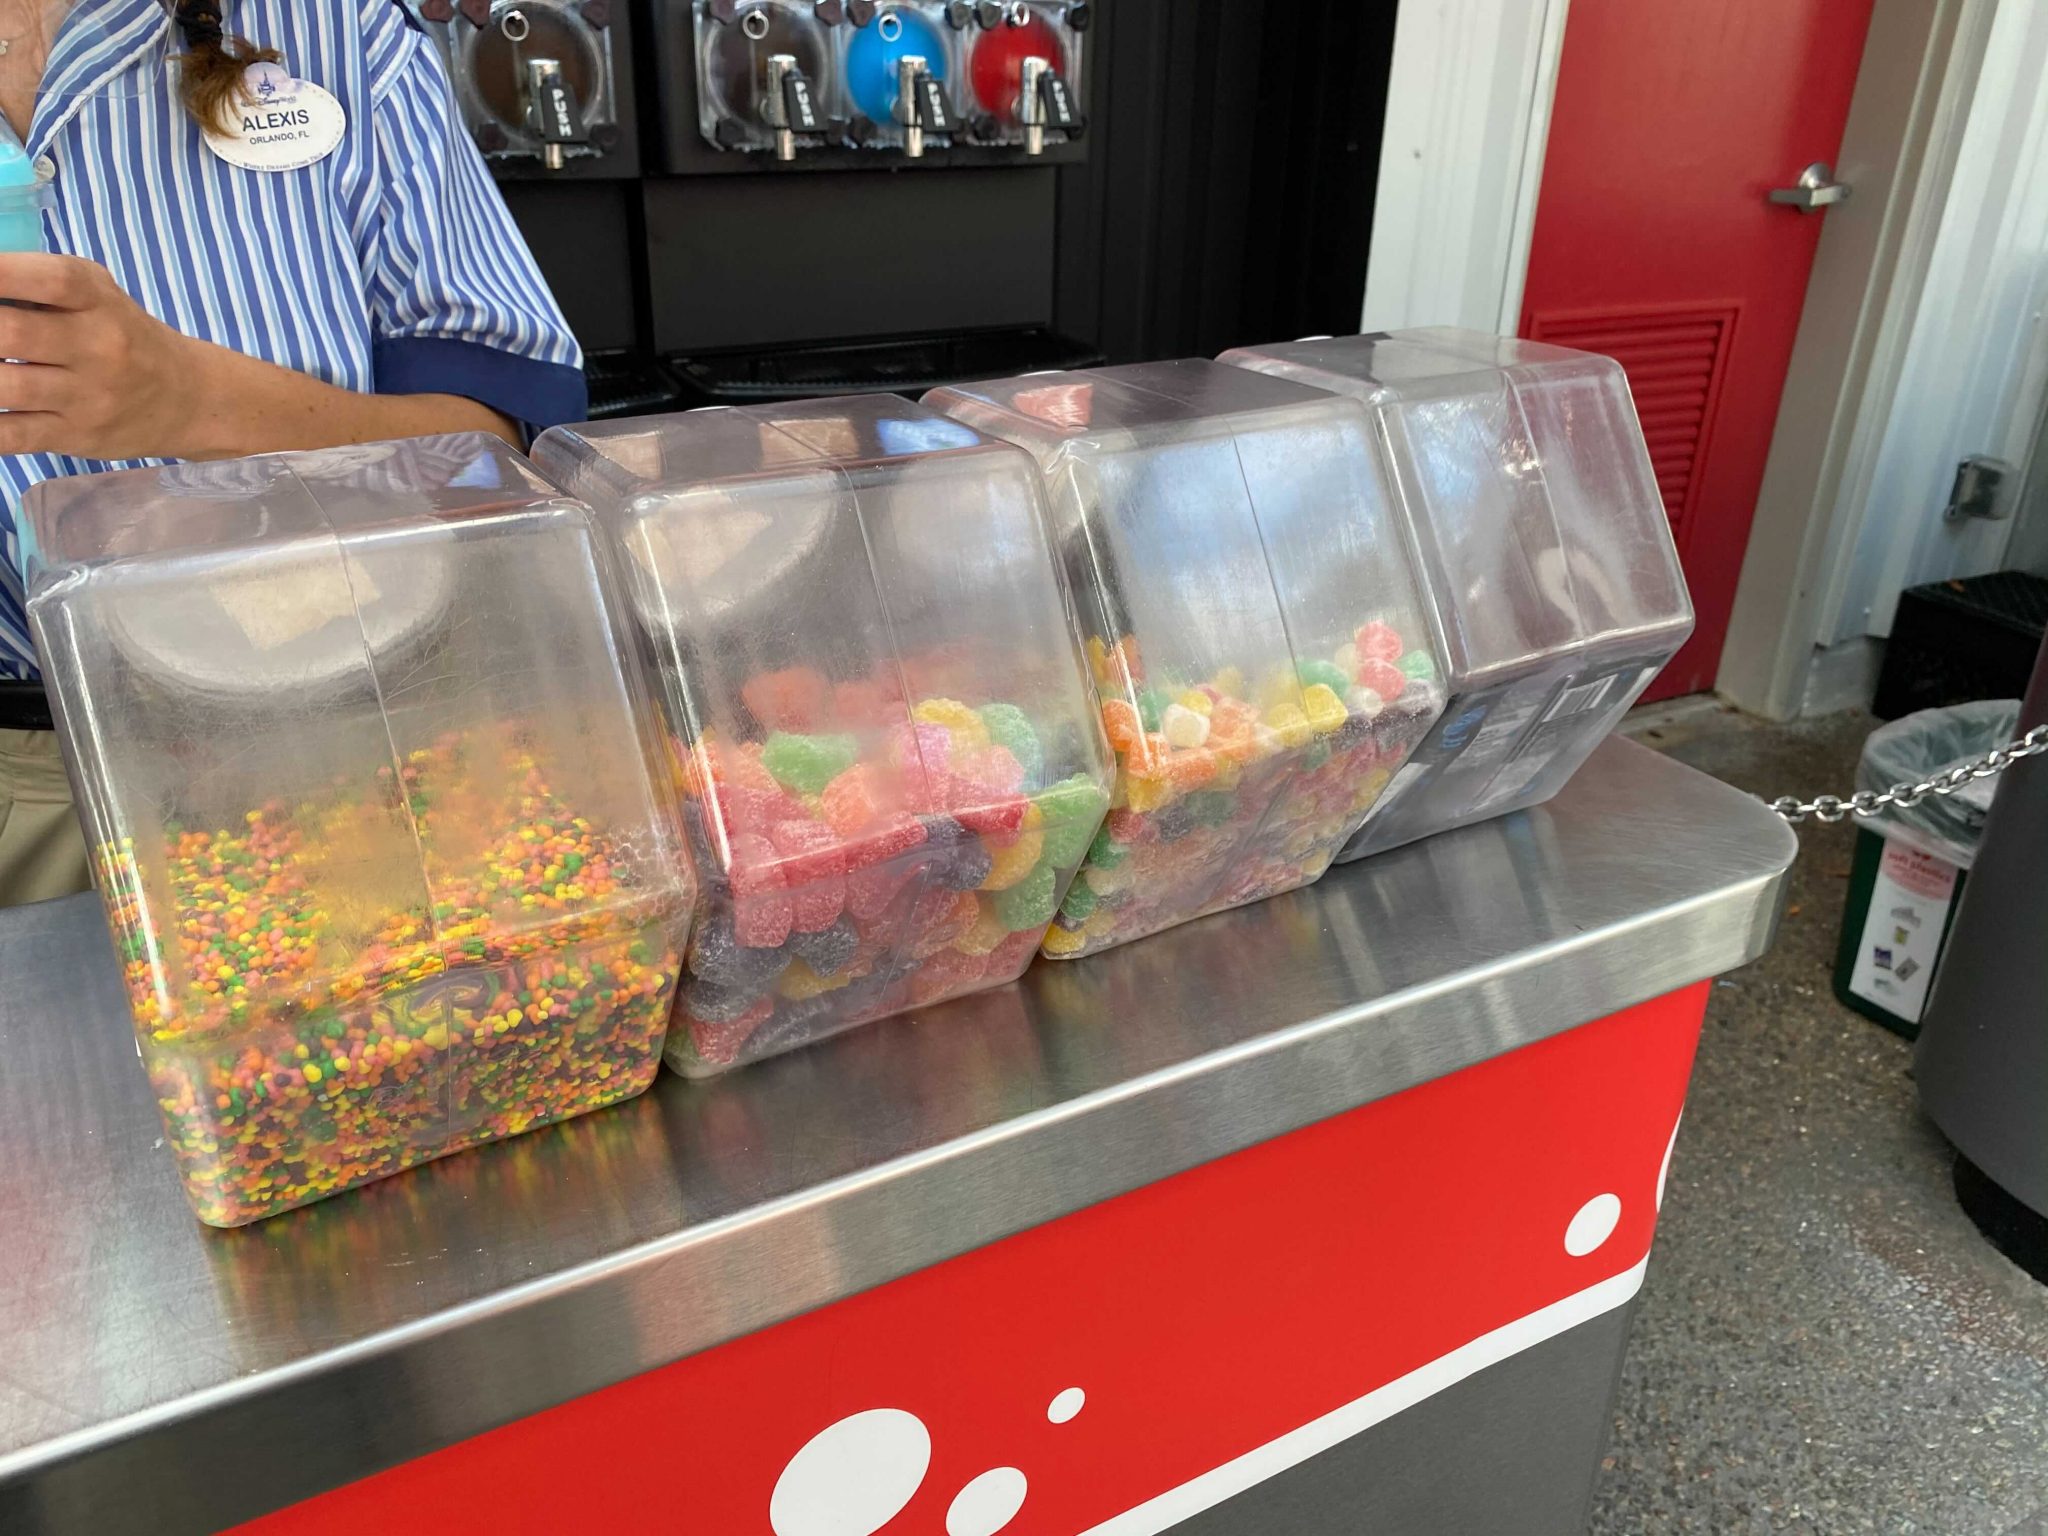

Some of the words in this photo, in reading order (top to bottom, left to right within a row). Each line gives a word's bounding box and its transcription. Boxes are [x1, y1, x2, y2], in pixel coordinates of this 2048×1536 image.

[242, 109, 310, 132] ALEXIS
[551, 89, 572, 136] PUSH
[794, 81, 815, 126] PUSH
[249, 132, 297, 145] ORLANDO,
[298, 130, 310, 138] FL
